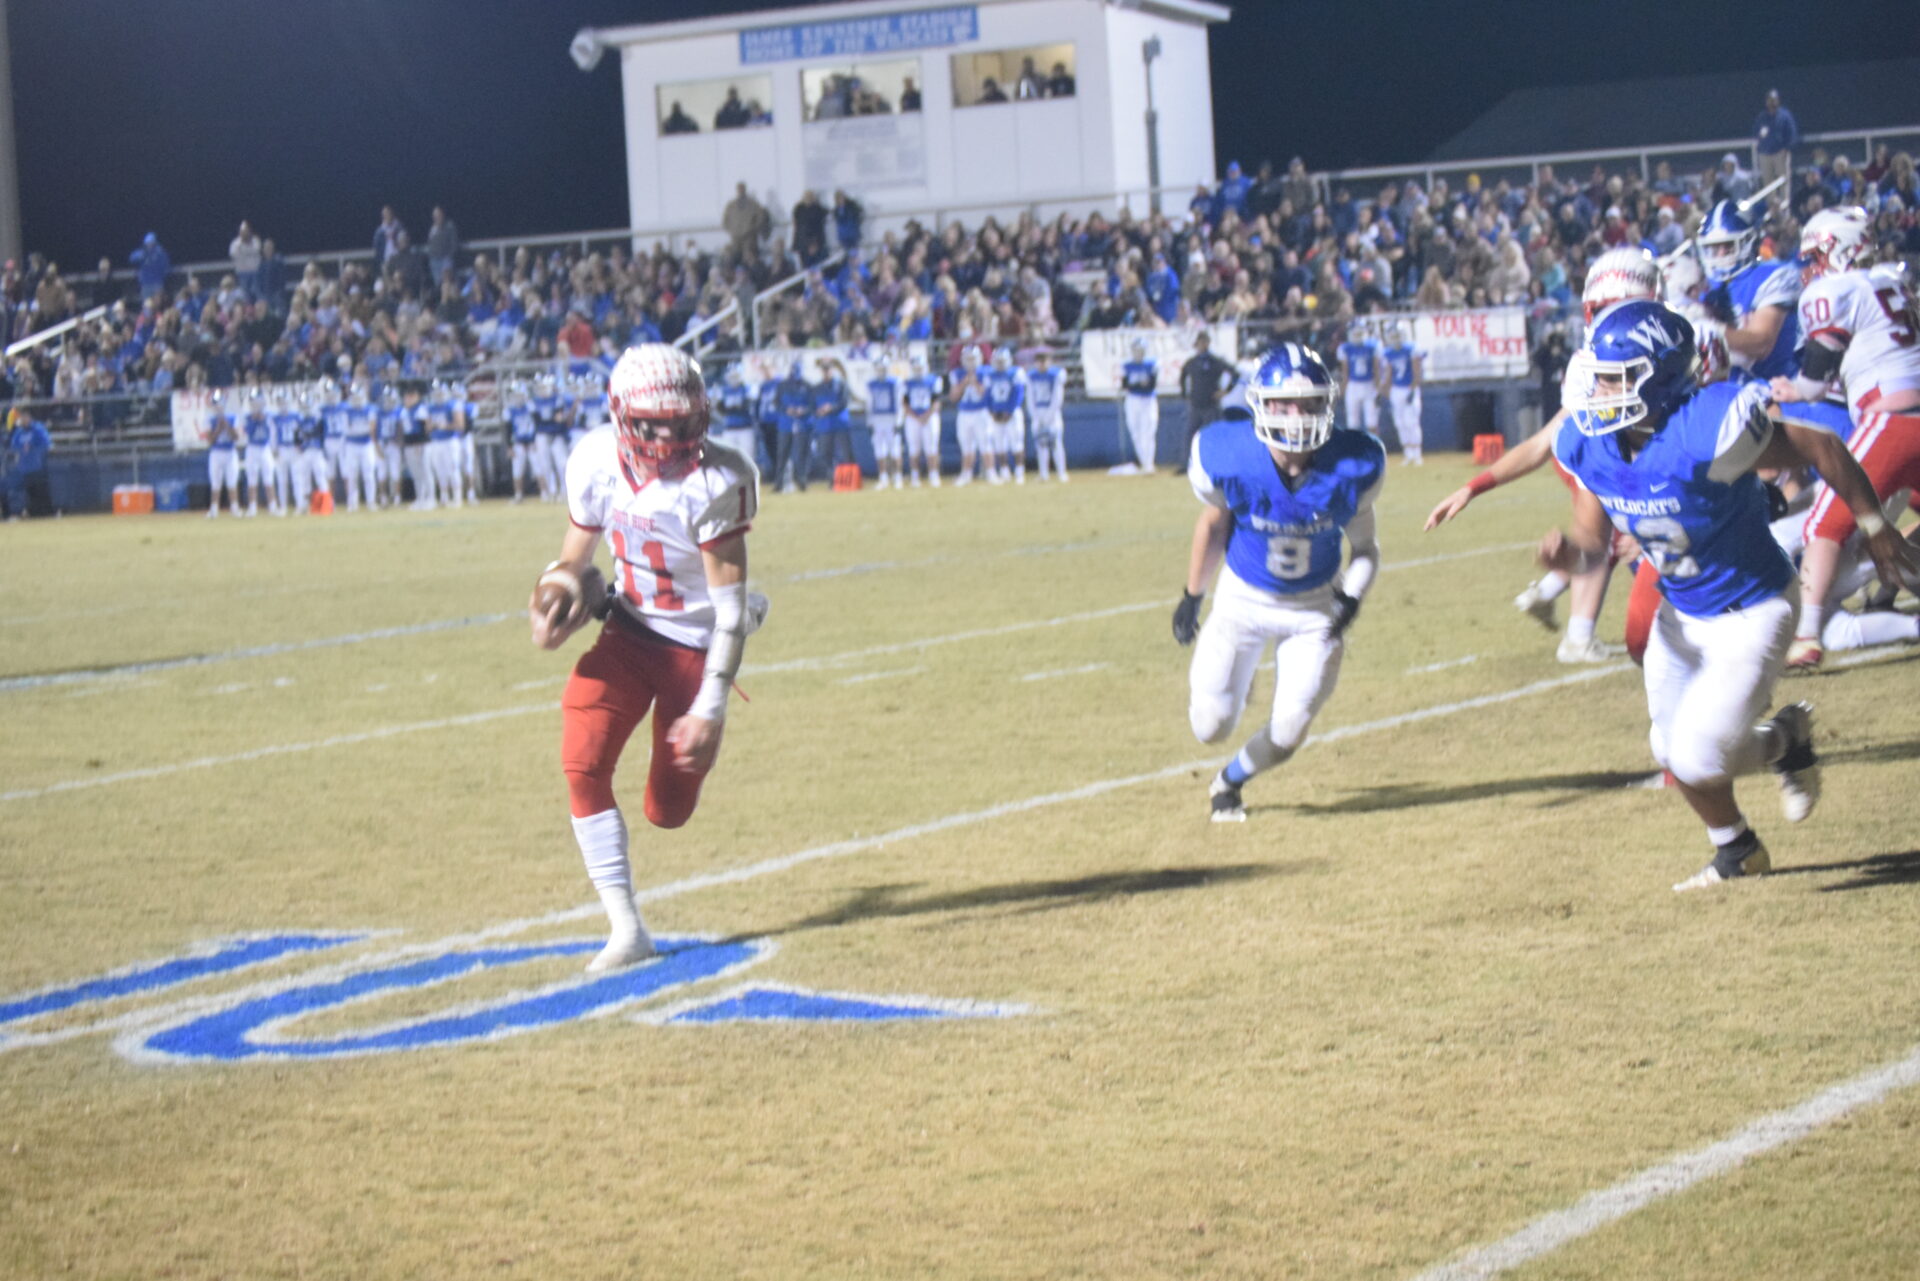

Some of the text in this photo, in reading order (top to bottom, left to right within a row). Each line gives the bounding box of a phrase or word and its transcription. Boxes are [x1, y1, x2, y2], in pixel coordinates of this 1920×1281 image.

[1802, 297, 1830, 329] 50
[1479, 334, 1526, 356] NEXT
[611, 530, 684, 611] 11
